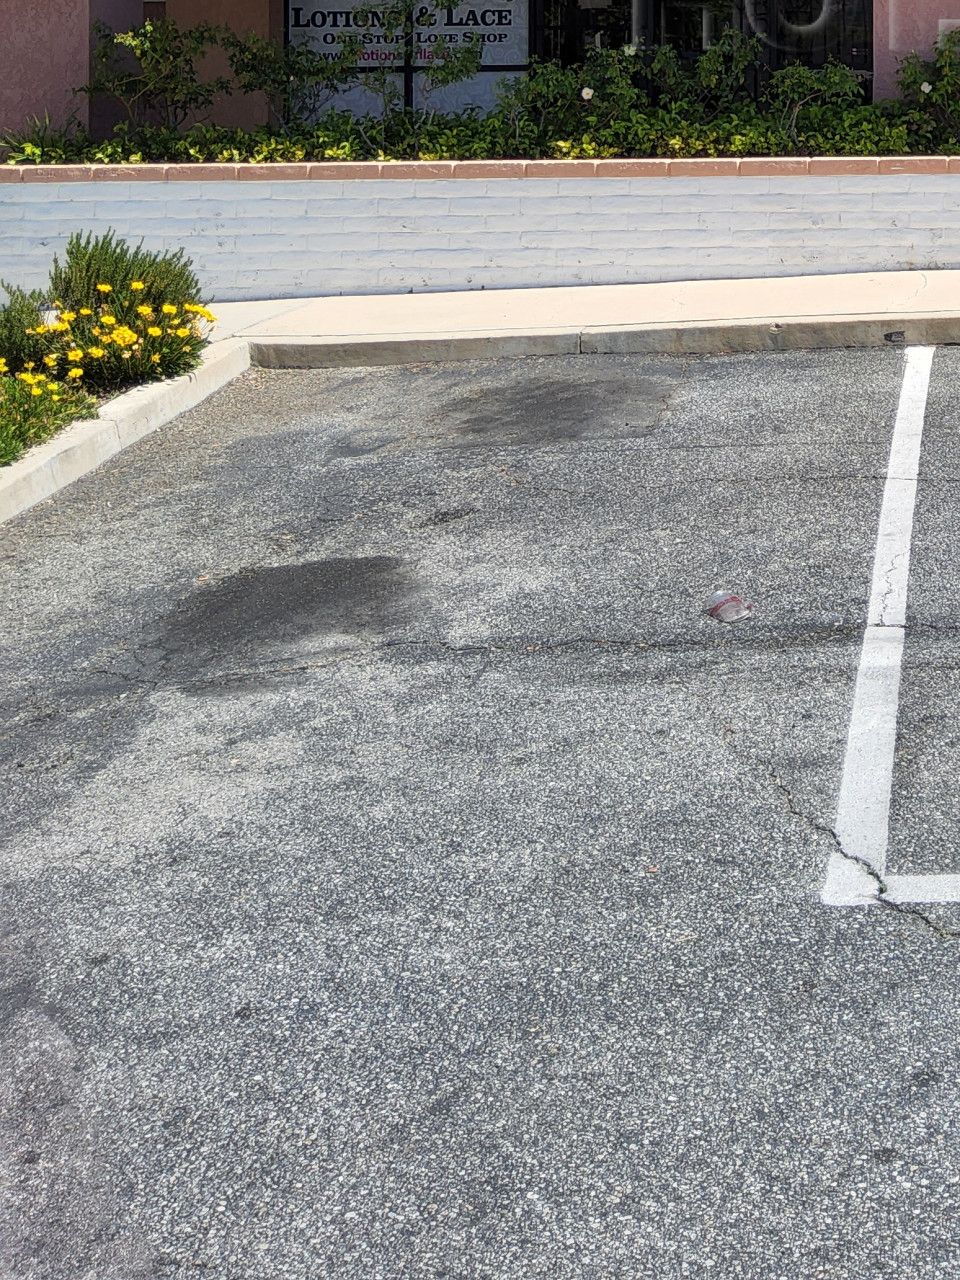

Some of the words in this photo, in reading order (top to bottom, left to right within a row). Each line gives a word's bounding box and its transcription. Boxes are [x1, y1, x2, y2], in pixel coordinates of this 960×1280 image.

[415, 6, 437, 27] &
[444, 5, 512, 26] LACE
[362, 32, 405, 45] STOP
